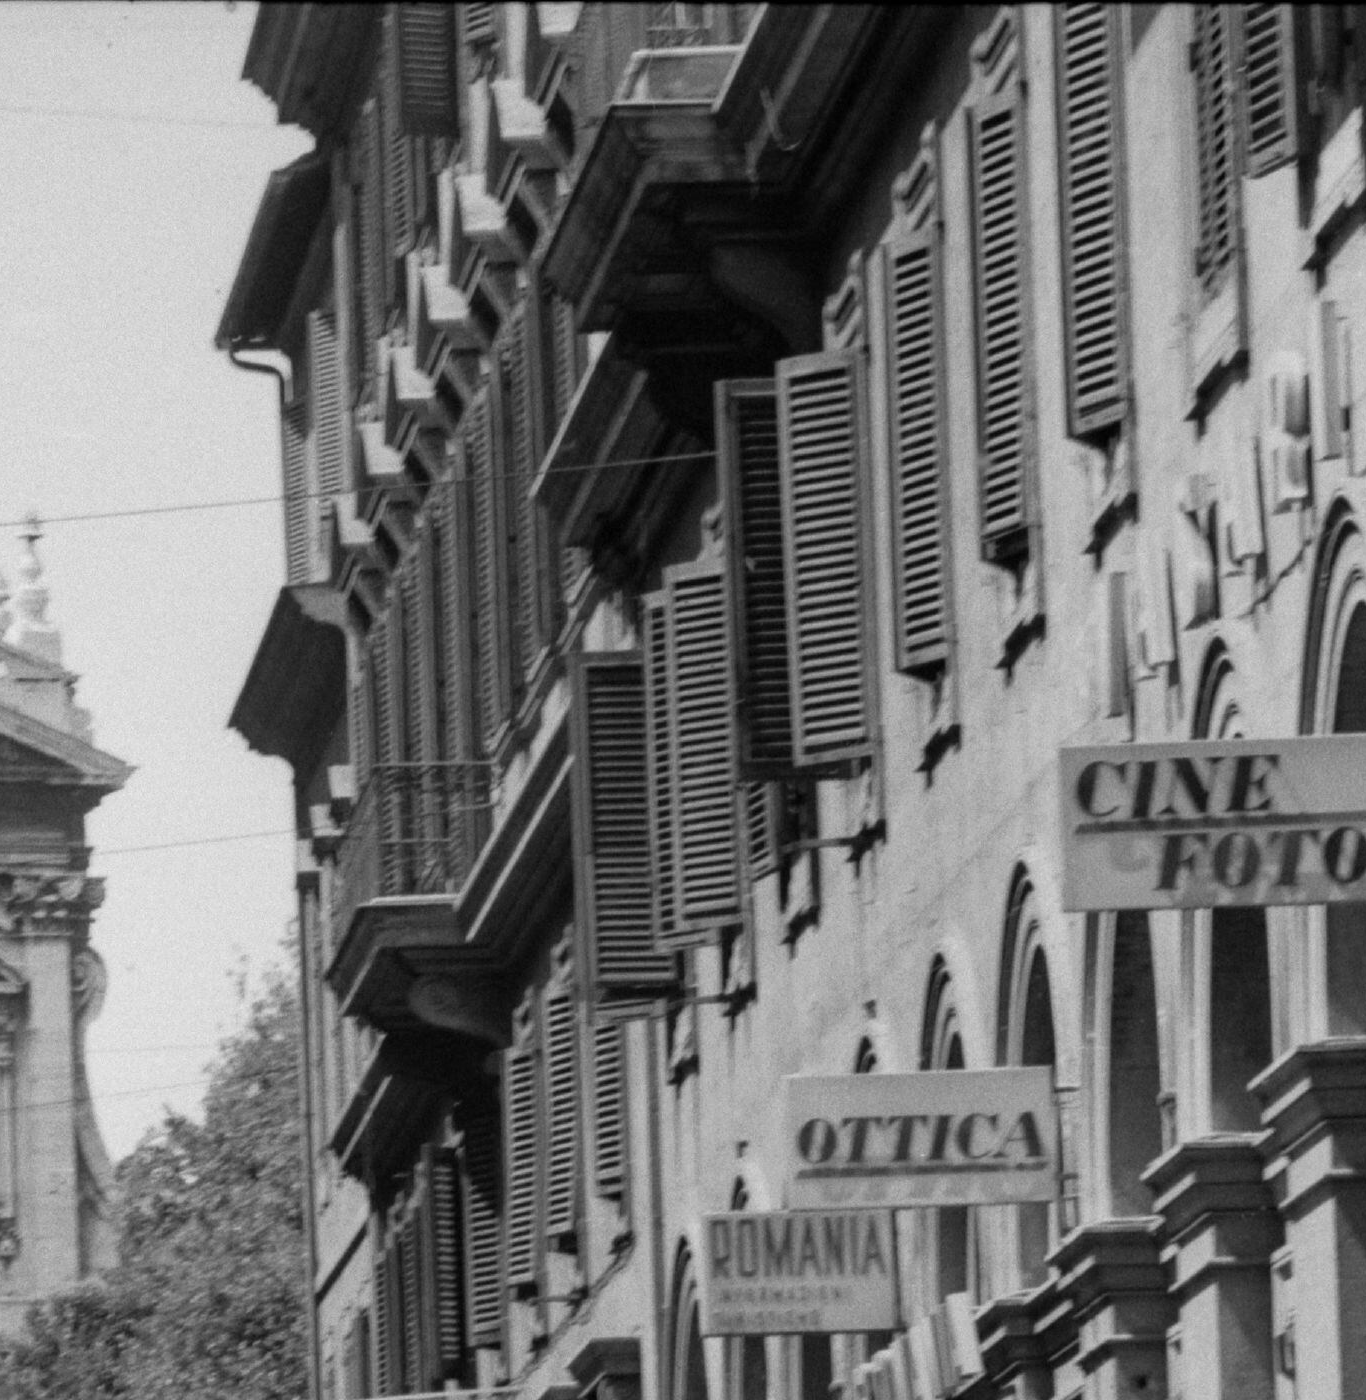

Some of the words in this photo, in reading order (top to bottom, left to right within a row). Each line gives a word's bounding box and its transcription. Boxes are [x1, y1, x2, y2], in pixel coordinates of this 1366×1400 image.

[1075, 755, 1281, 818] CINE
[798, 1111, 1044, 1164] OTTICA
[709, 1215, 887, 1277] ROMANIA
